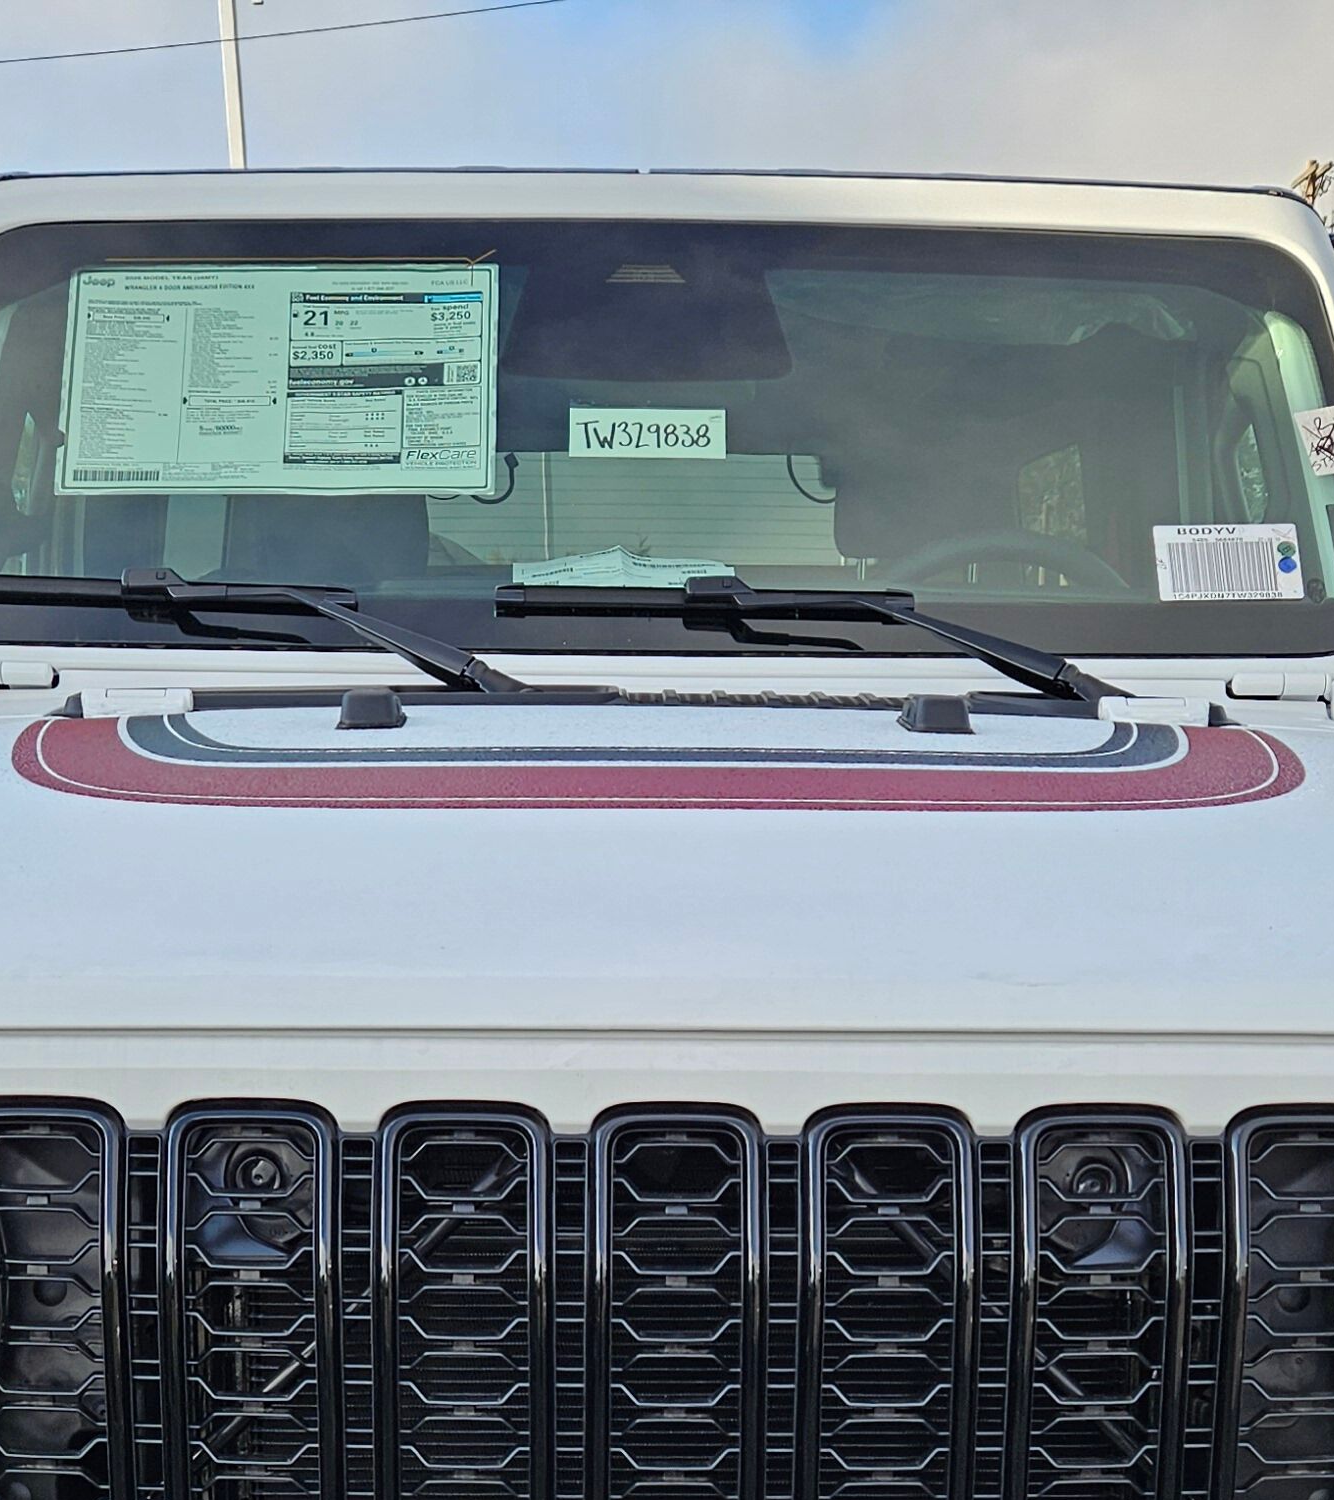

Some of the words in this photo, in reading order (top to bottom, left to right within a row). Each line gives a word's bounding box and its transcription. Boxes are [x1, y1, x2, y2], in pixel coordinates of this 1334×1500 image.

[82, 276, 116, 288] Jeep
[321, 294, 349, 302] Economy
[442, 303, 469, 311] spend
[303, 310, 329, 326] 21
[430, 311, 471, 322] $3,250
[292, 350, 334, 361] $2,350
[289, 378, 355, 387] fueleconomy.gov
[576, 420, 711, 450] TW329838
[406, 449, 476, 460] FlexCare
